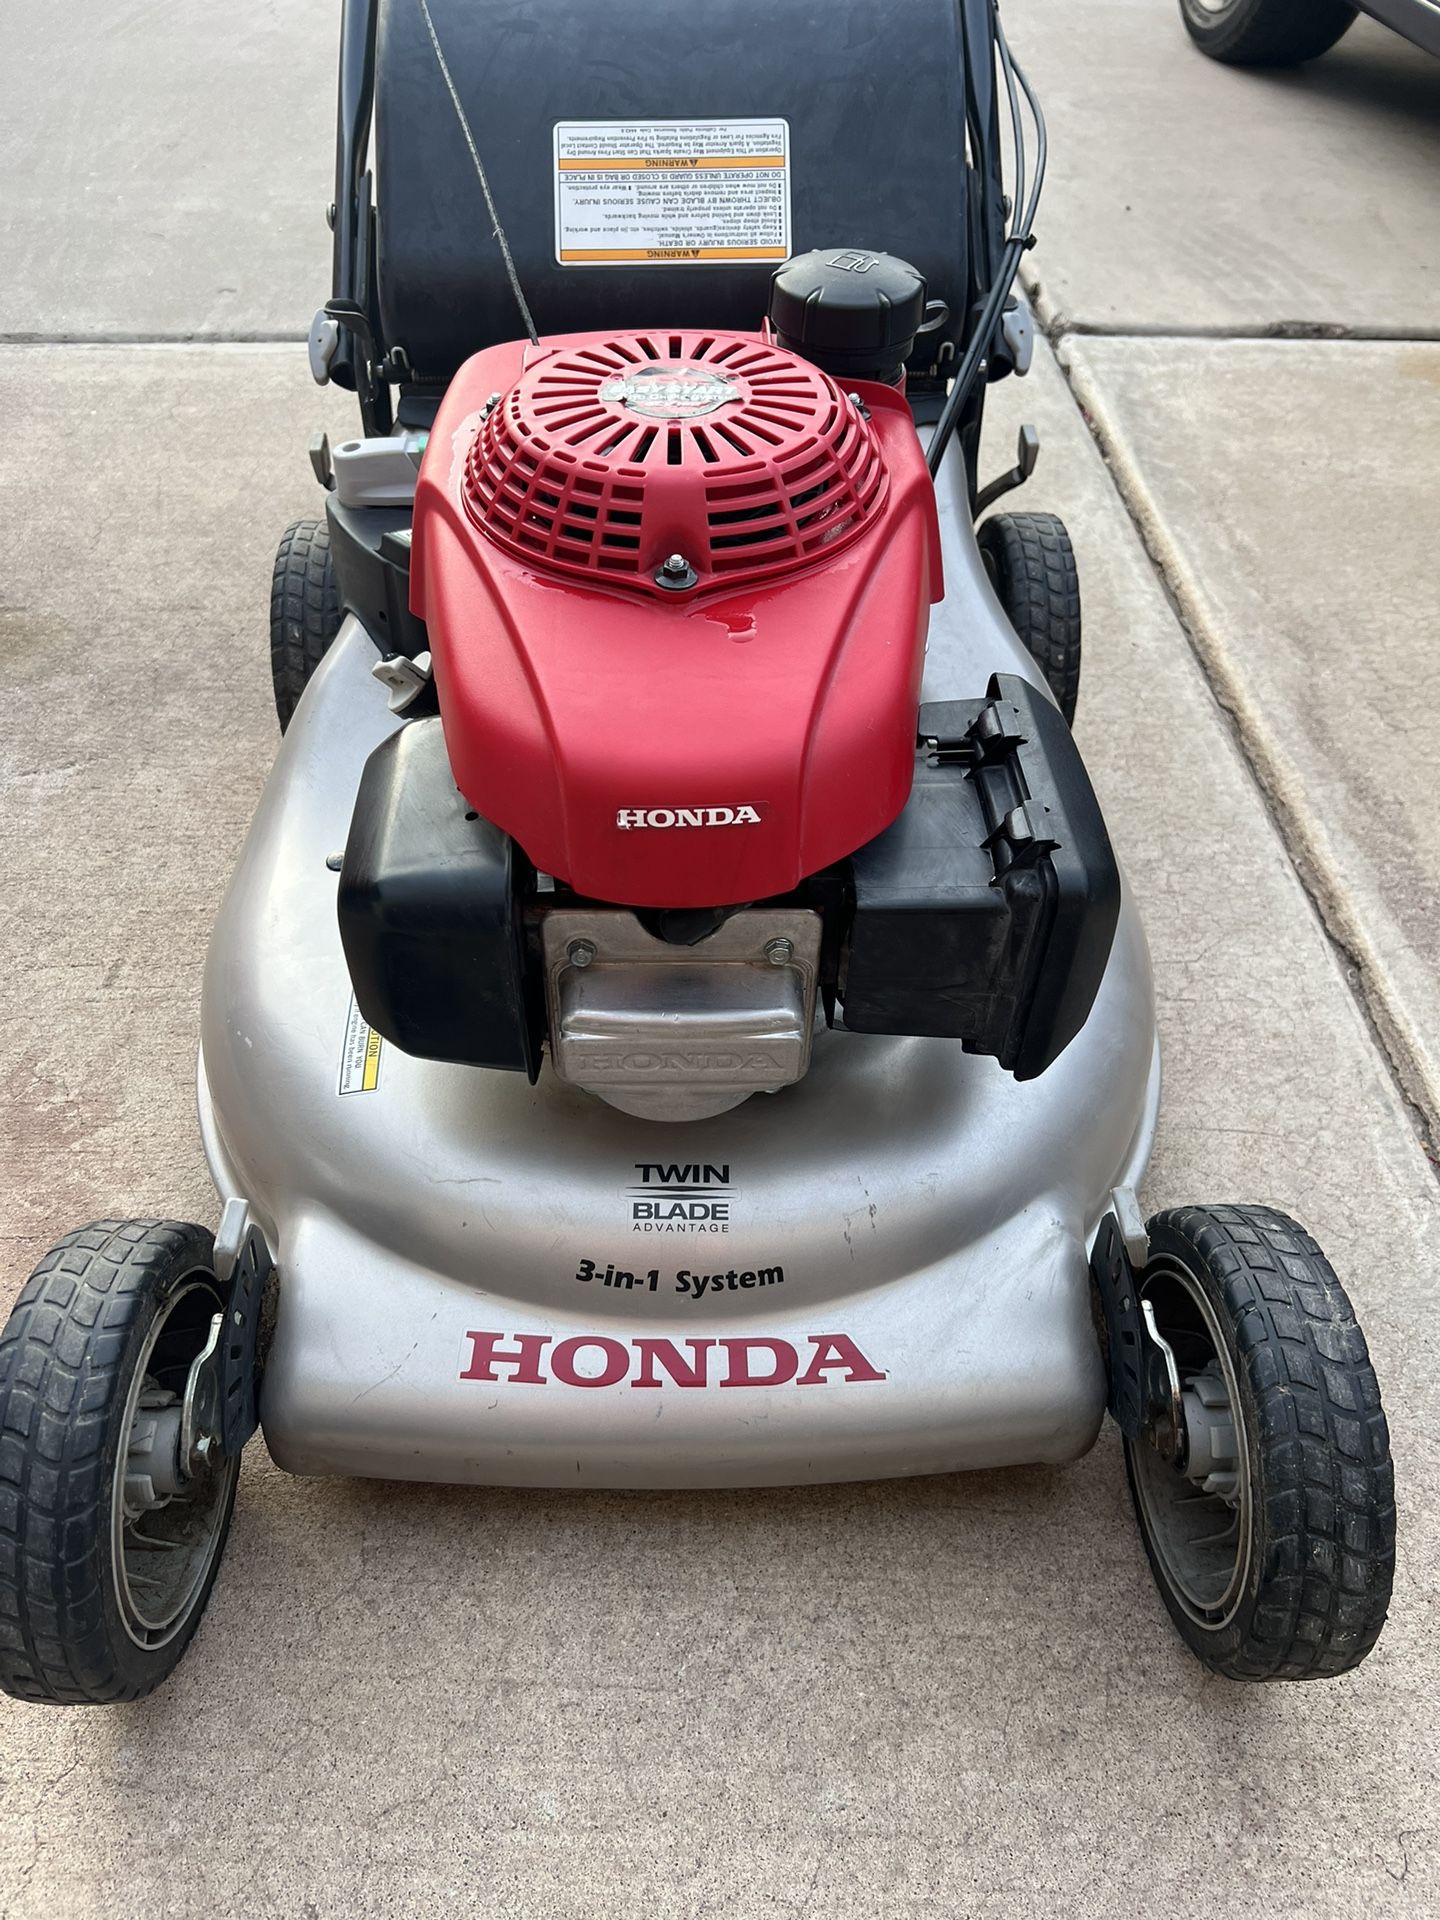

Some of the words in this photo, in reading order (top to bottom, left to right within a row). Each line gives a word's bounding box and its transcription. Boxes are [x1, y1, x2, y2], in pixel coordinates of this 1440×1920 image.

[616, 805, 762, 829] HONDA
[349, 1034, 358, 1046] has
[357, 1036, 366, 1053] BURN
[346, 1047, 356, 1062] been
[579, 1053, 786, 1072] HONDA
[634, 1164, 730, 1184] TWIN
[632, 1202, 730, 1220] BLADE
[632, 1222, 729, 1233] ADVANTAGE
[575, 1259, 660, 1292] 3-in-1
[675, 1266, 784, 1299] System
[459, 1330, 887, 1388] HONDA
